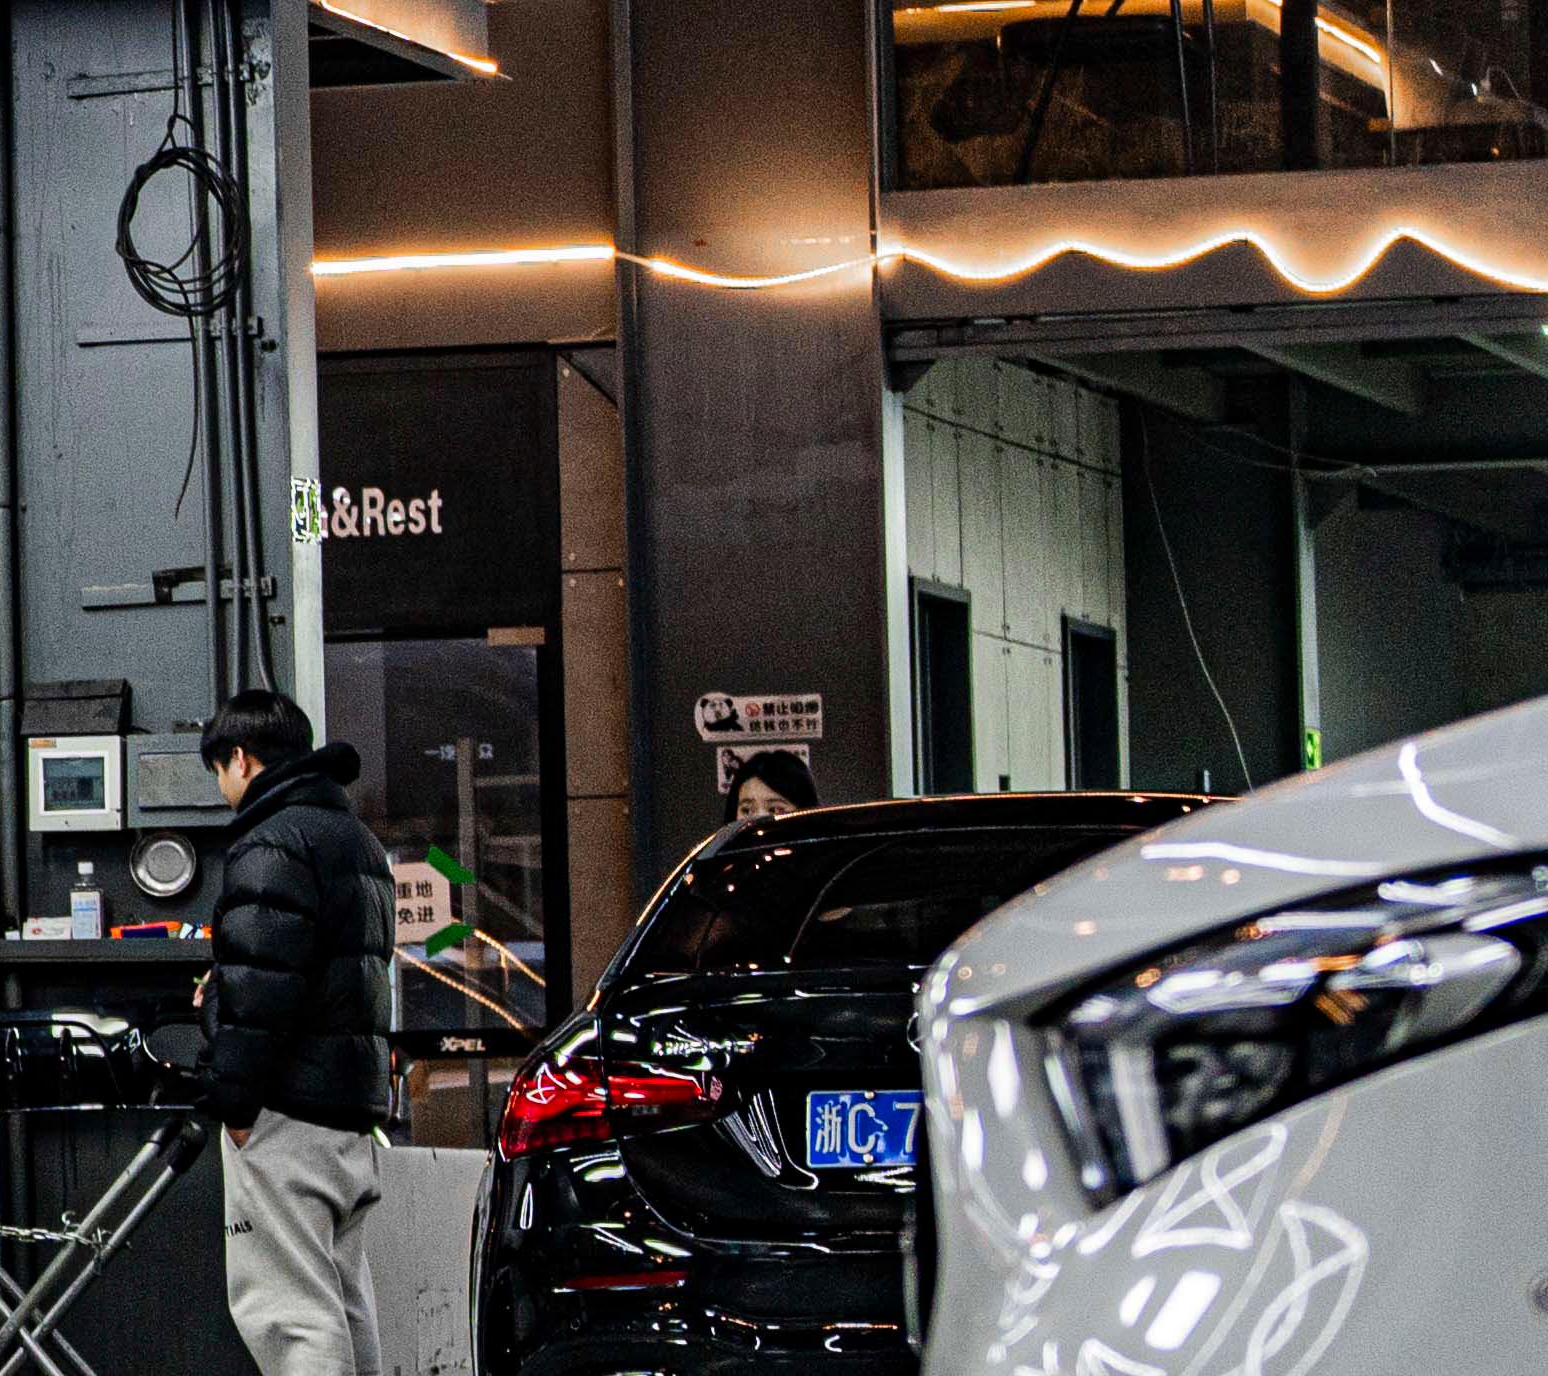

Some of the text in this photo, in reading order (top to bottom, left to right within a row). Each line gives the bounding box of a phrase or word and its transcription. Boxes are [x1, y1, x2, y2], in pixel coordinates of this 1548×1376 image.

[397, 880, 433, 899] 重地
[398, 905, 435, 925] 免进
[440, 1036, 486, 1052] XPEL
